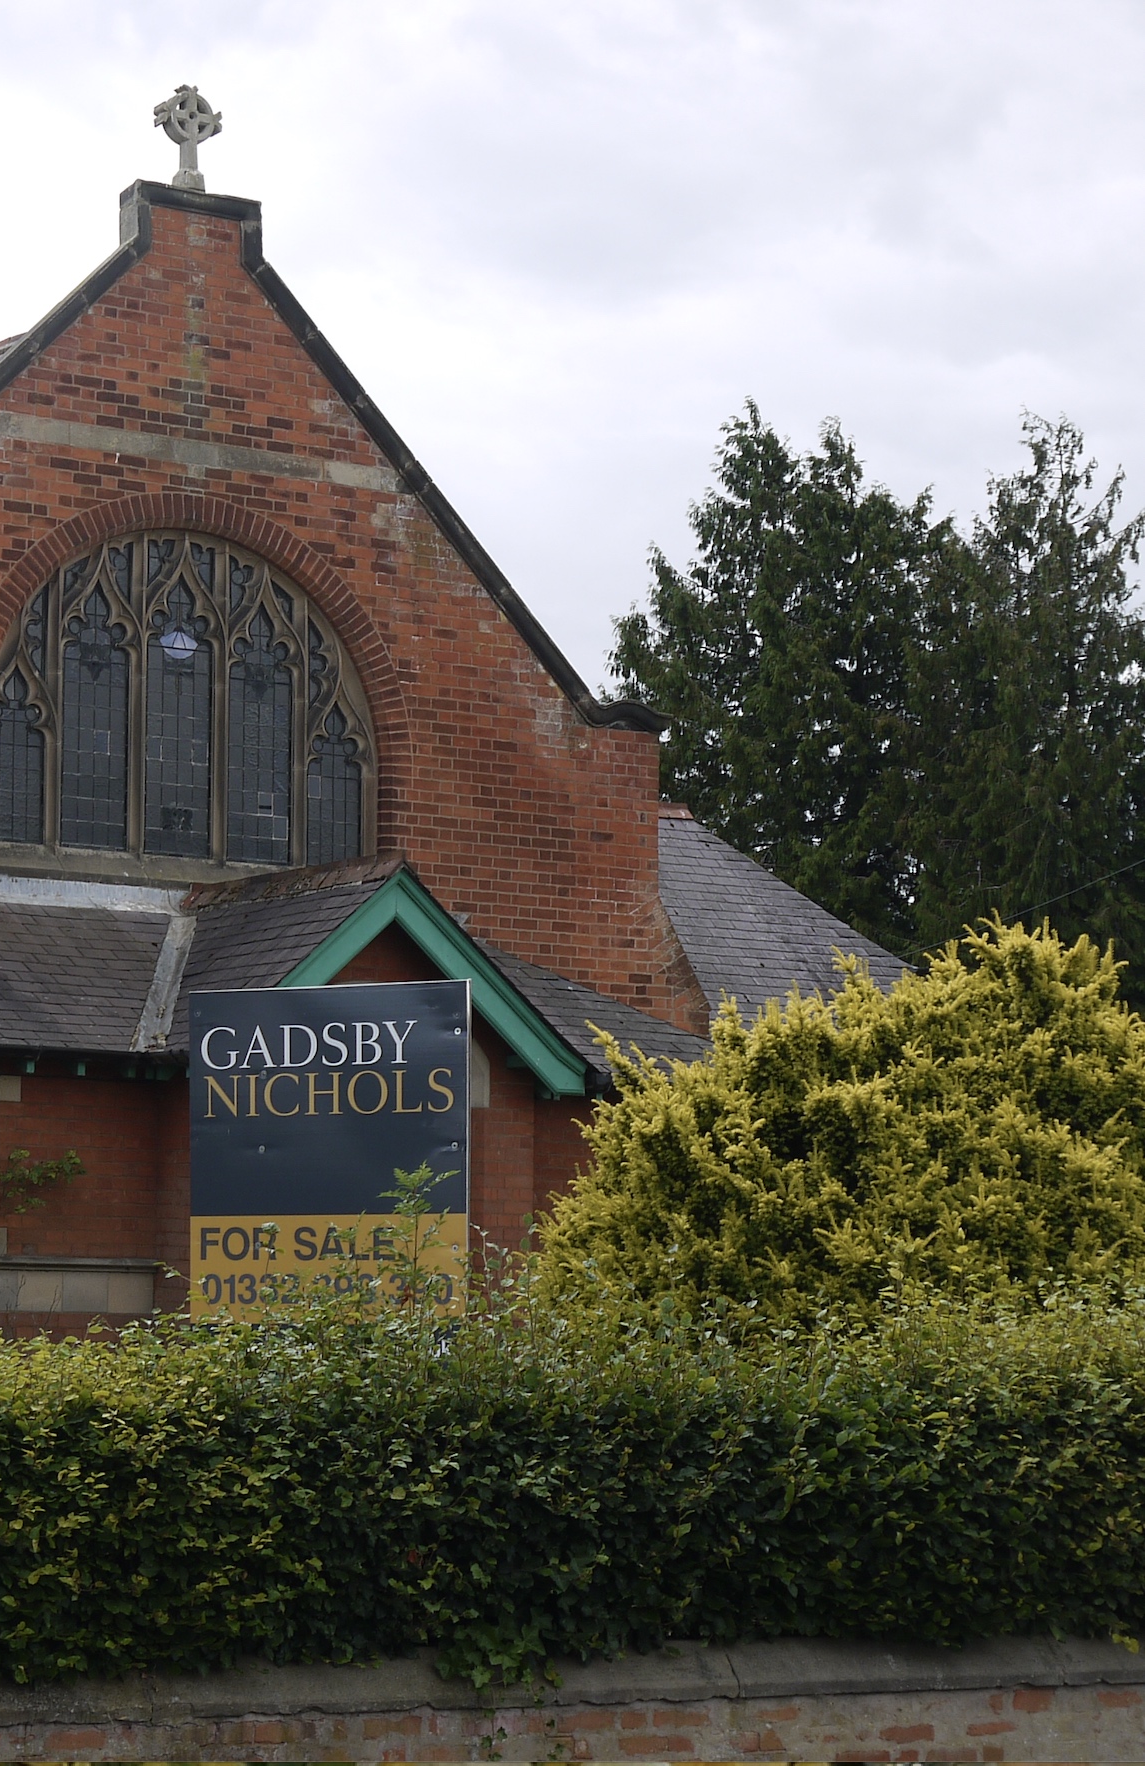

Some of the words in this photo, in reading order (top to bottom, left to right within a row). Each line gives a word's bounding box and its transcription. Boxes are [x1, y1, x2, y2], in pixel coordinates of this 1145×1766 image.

[200, 1019, 418, 1071] GADSBY
[203, 1067, 455, 1118] NICHOLS
[200, 1226, 277, 1262] FOR
[293, 1226, 396, 1262] SALE
